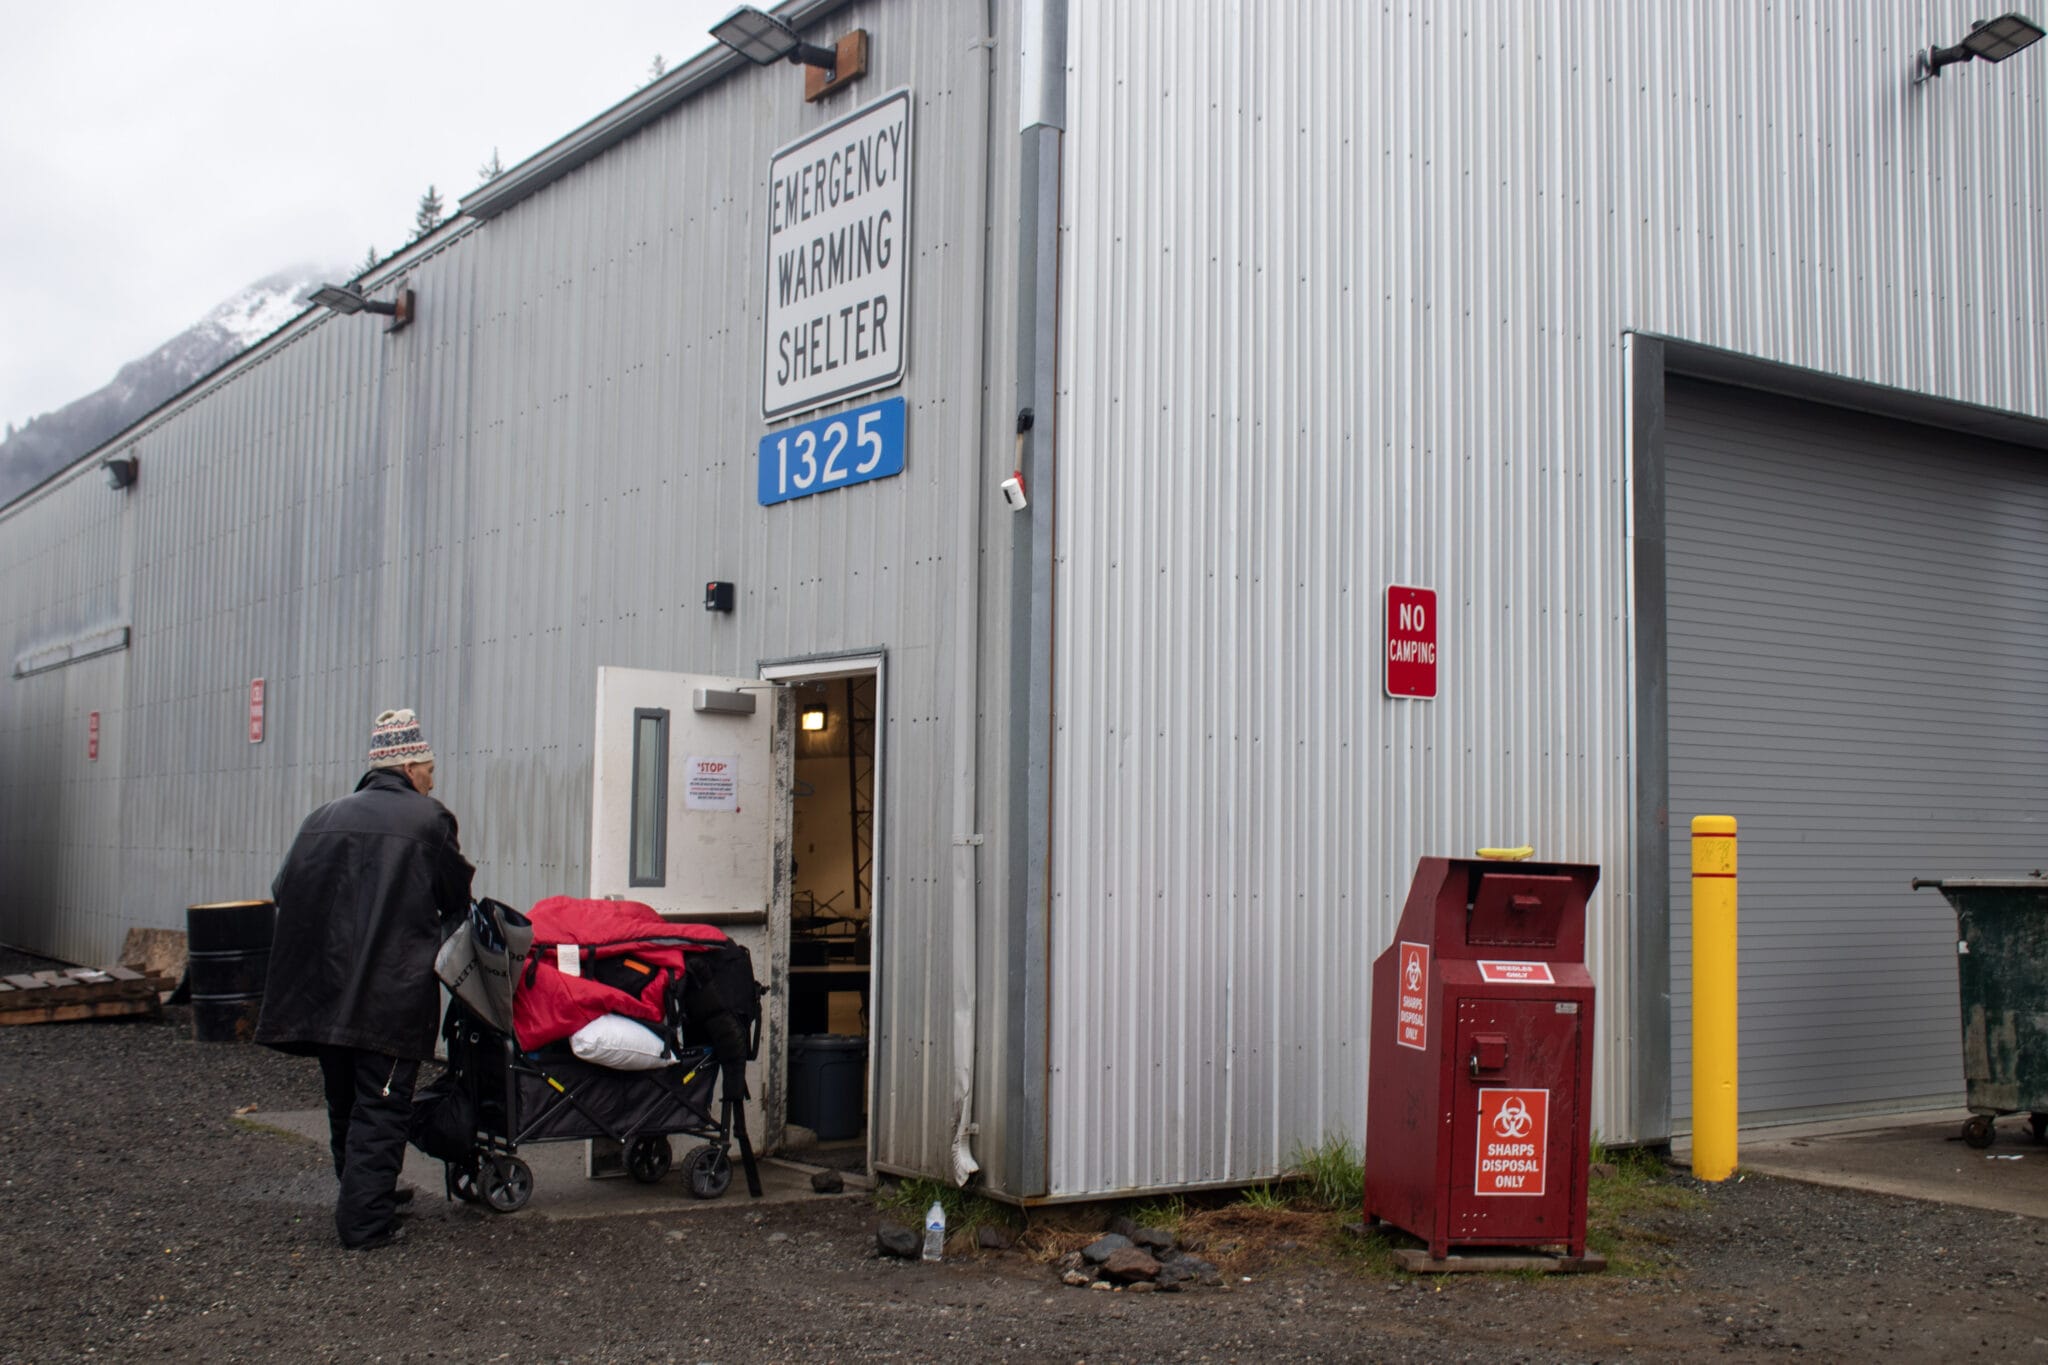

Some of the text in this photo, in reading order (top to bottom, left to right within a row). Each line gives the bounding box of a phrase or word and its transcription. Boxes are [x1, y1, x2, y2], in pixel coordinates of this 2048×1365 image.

[772, 121, 903, 235] EMERGENCY
[778, 209, 892, 309] WARMING
[777, 295, 888, 386] SHELTER
[777, 410, 882, 494] 1325
[1400, 603, 1425, 632] NO
[1390, 639, 1435, 664] CAMPING
[1488, 1143, 1535, 1156] SHARPS
[1482, 1159, 1539, 1172] DISPOSAL
[1495, 1175, 1525, 1188] ONLY
